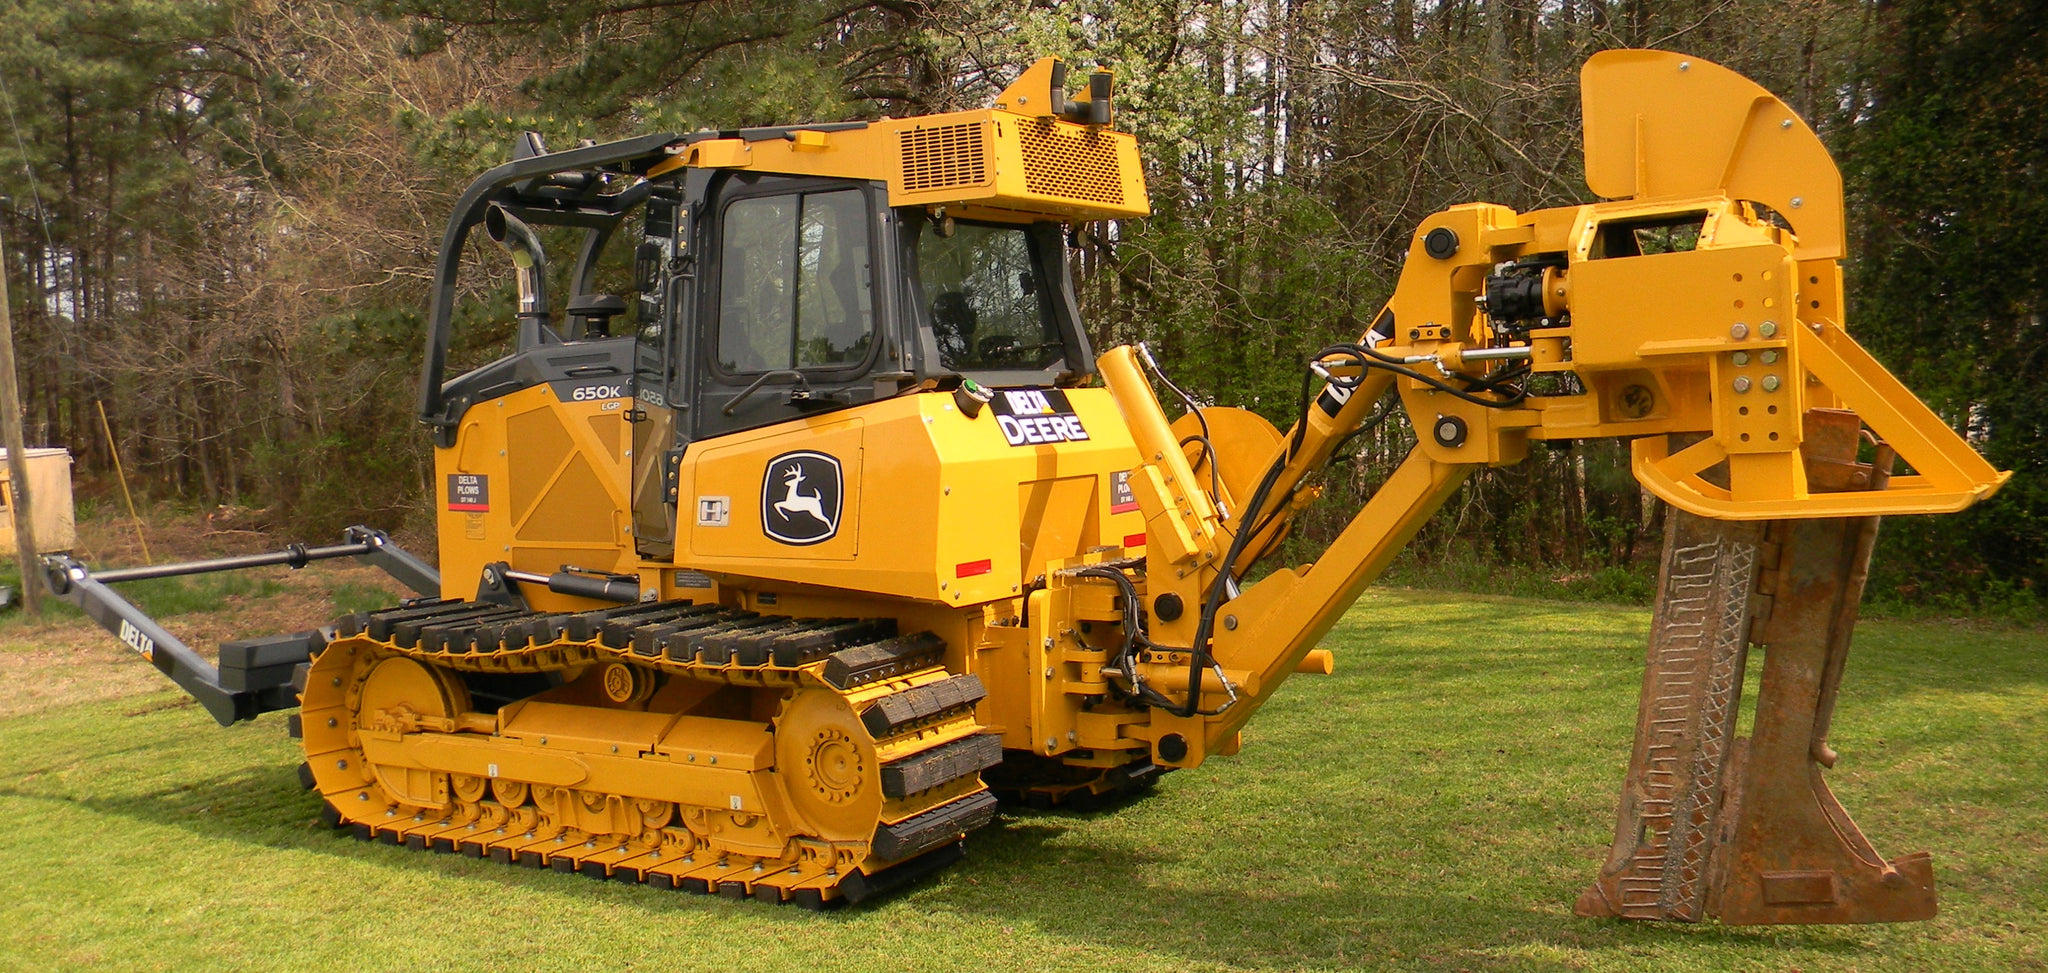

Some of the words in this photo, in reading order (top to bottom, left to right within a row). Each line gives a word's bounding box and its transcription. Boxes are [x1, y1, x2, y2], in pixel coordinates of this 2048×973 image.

[573, 385, 621, 401] 650K
[602, 402, 620, 411] LGP
[1004, 390, 1054, 415] DELTA
[996, 414, 1089, 445] DEERE
[458, 475, 478, 485] DELTA
[457, 485, 480, 495] PLOWS
[1117, 483, 1131, 494] PLO
[120, 618, 154, 657] DELTA
